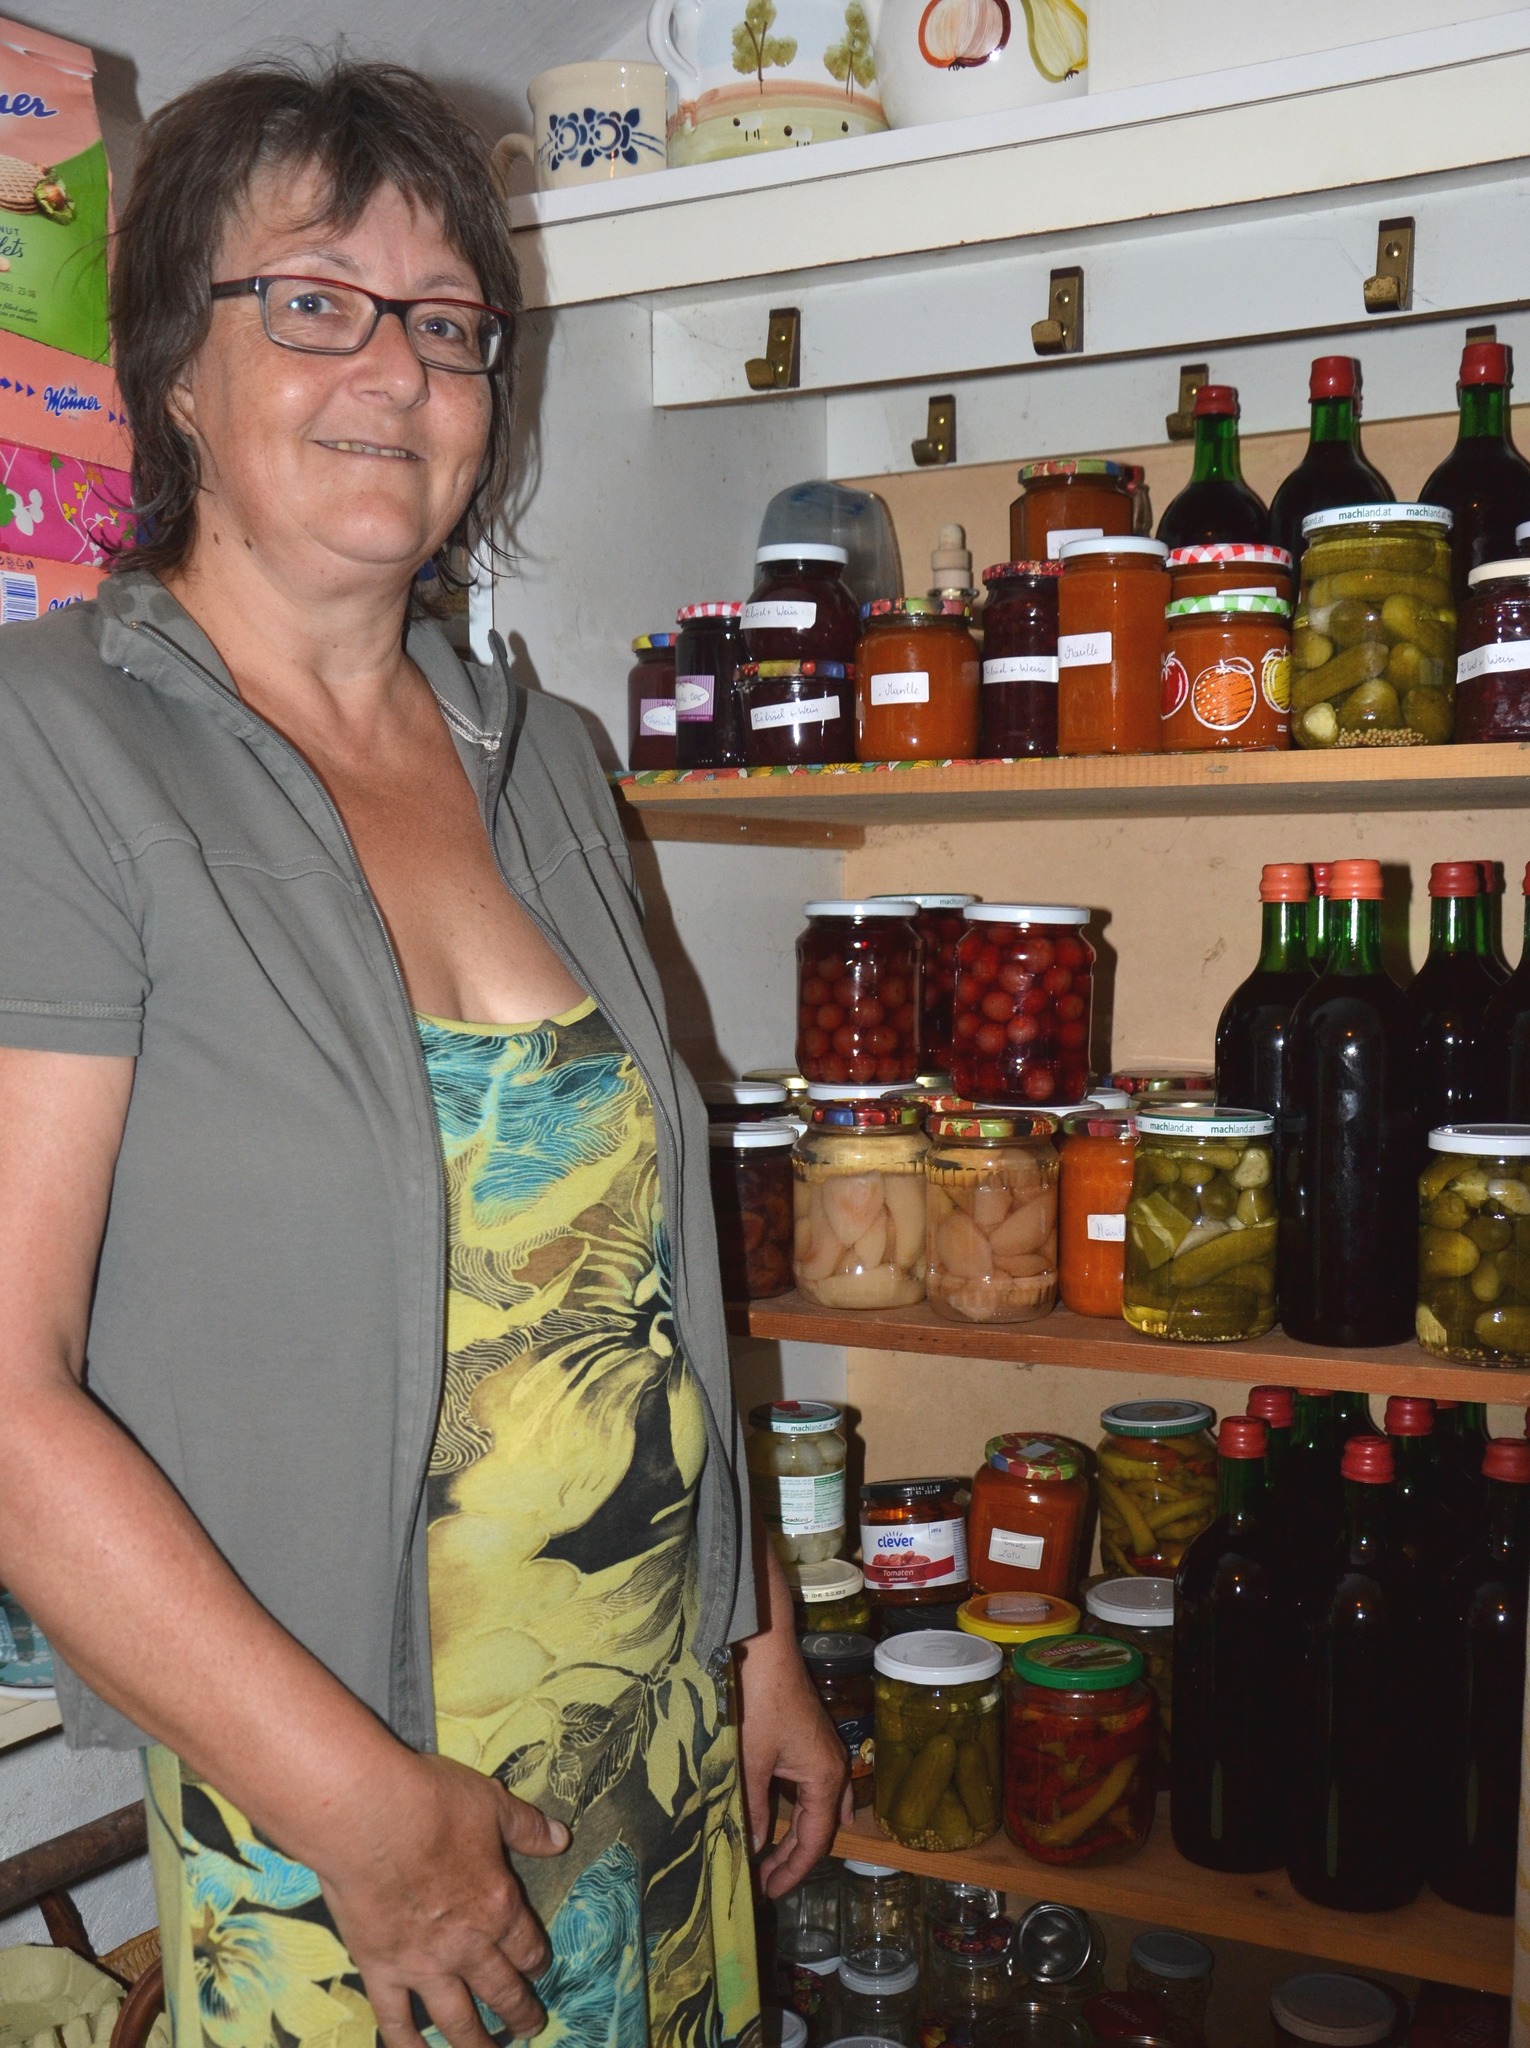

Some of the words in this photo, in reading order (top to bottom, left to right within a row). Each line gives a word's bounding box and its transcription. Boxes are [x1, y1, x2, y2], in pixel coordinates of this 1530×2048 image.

[43, 385, 103, 417] Manner
[1338, 507, 1392, 520] machland.at
[1150, 1121, 1194, 1133] machland.at
[1210, 1125, 1256, 1134] machland.at
[877, 1536, 915, 1548] clever
[883, 1568, 914, 1577] Tomaten
